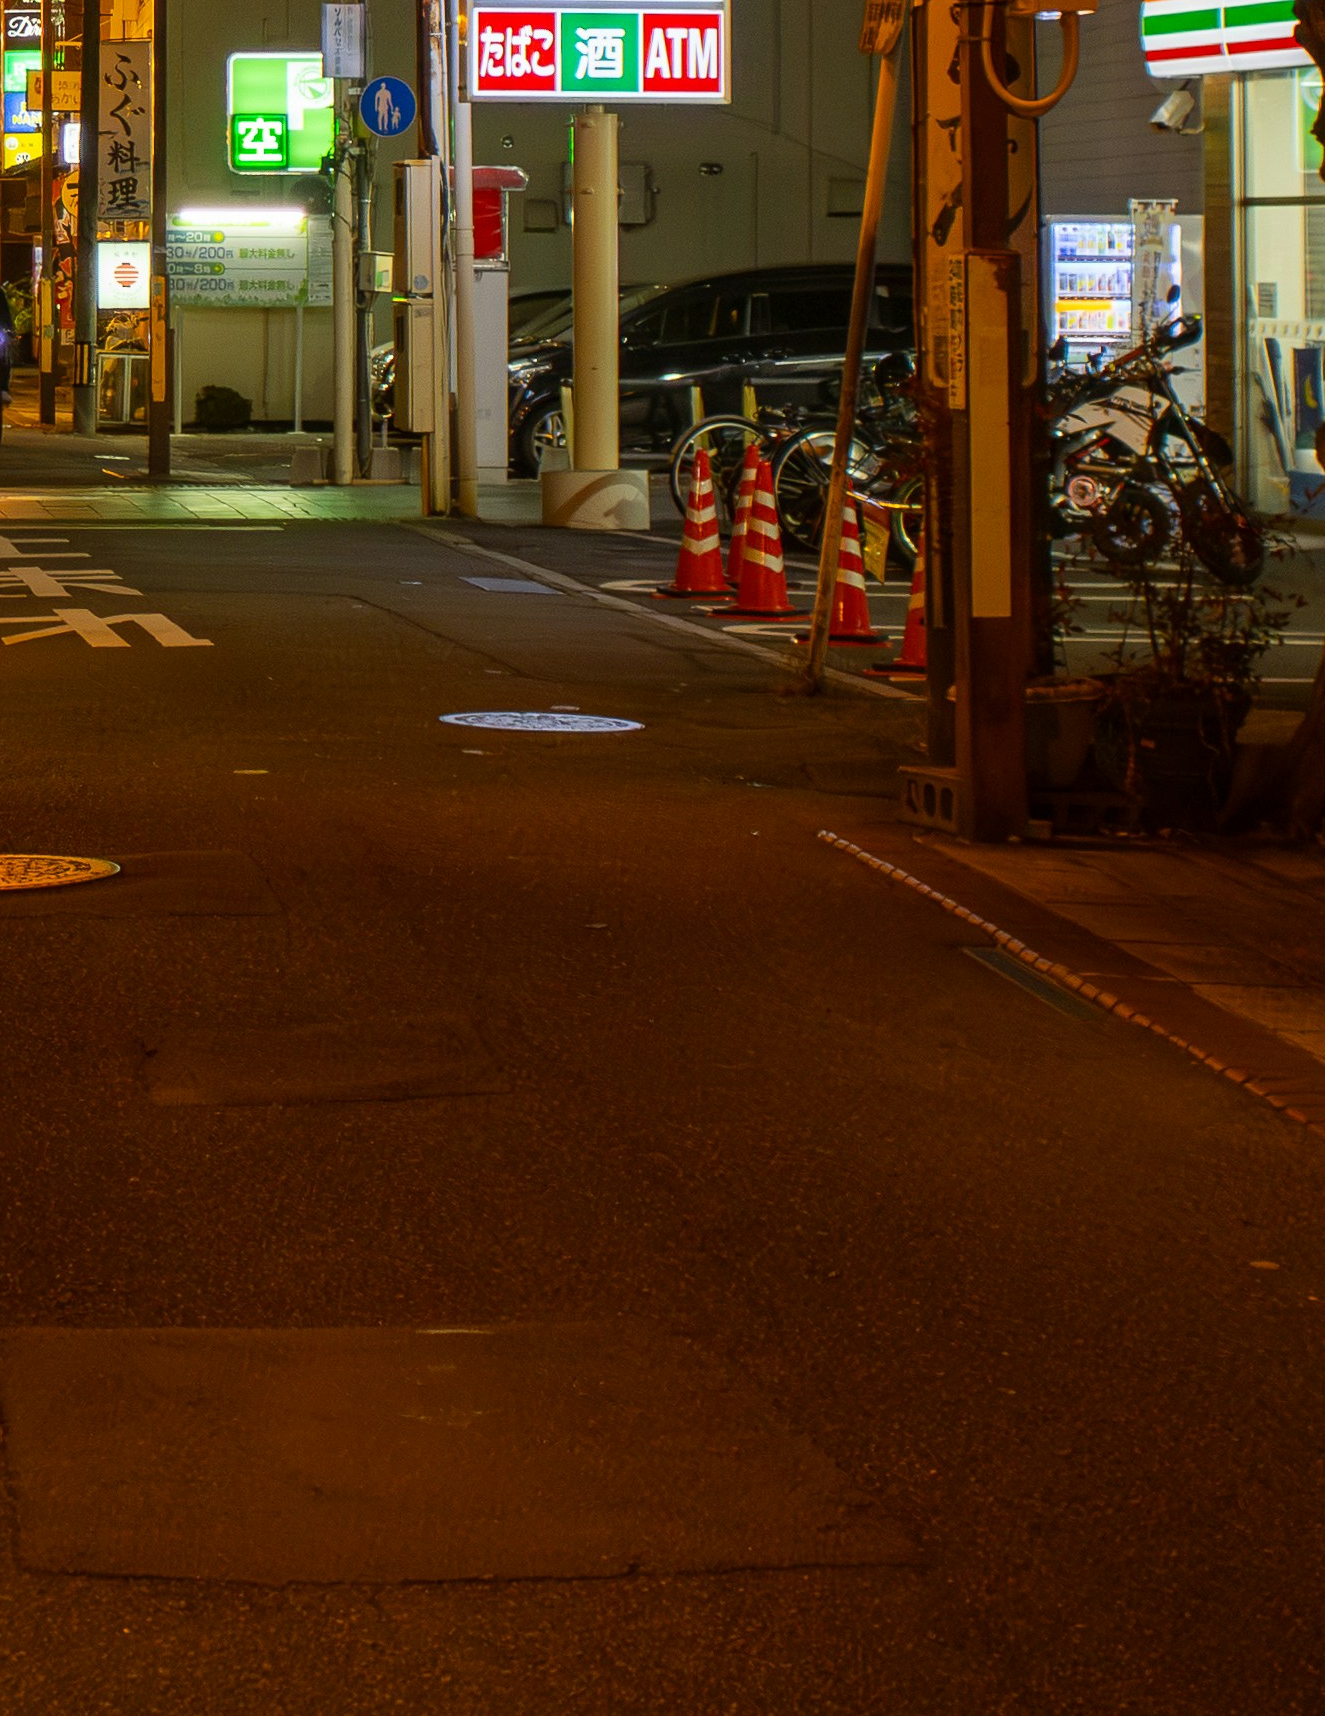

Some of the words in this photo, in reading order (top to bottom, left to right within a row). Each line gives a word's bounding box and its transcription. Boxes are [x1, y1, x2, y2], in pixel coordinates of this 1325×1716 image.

[479, 25, 555, 78] たばこ
[574, 27, 626, 80] 酒
[644, 27, 719, 80] ATM
[104, 51, 147, 209] ふぐ料理
[237, 117, 284, 162] 空
